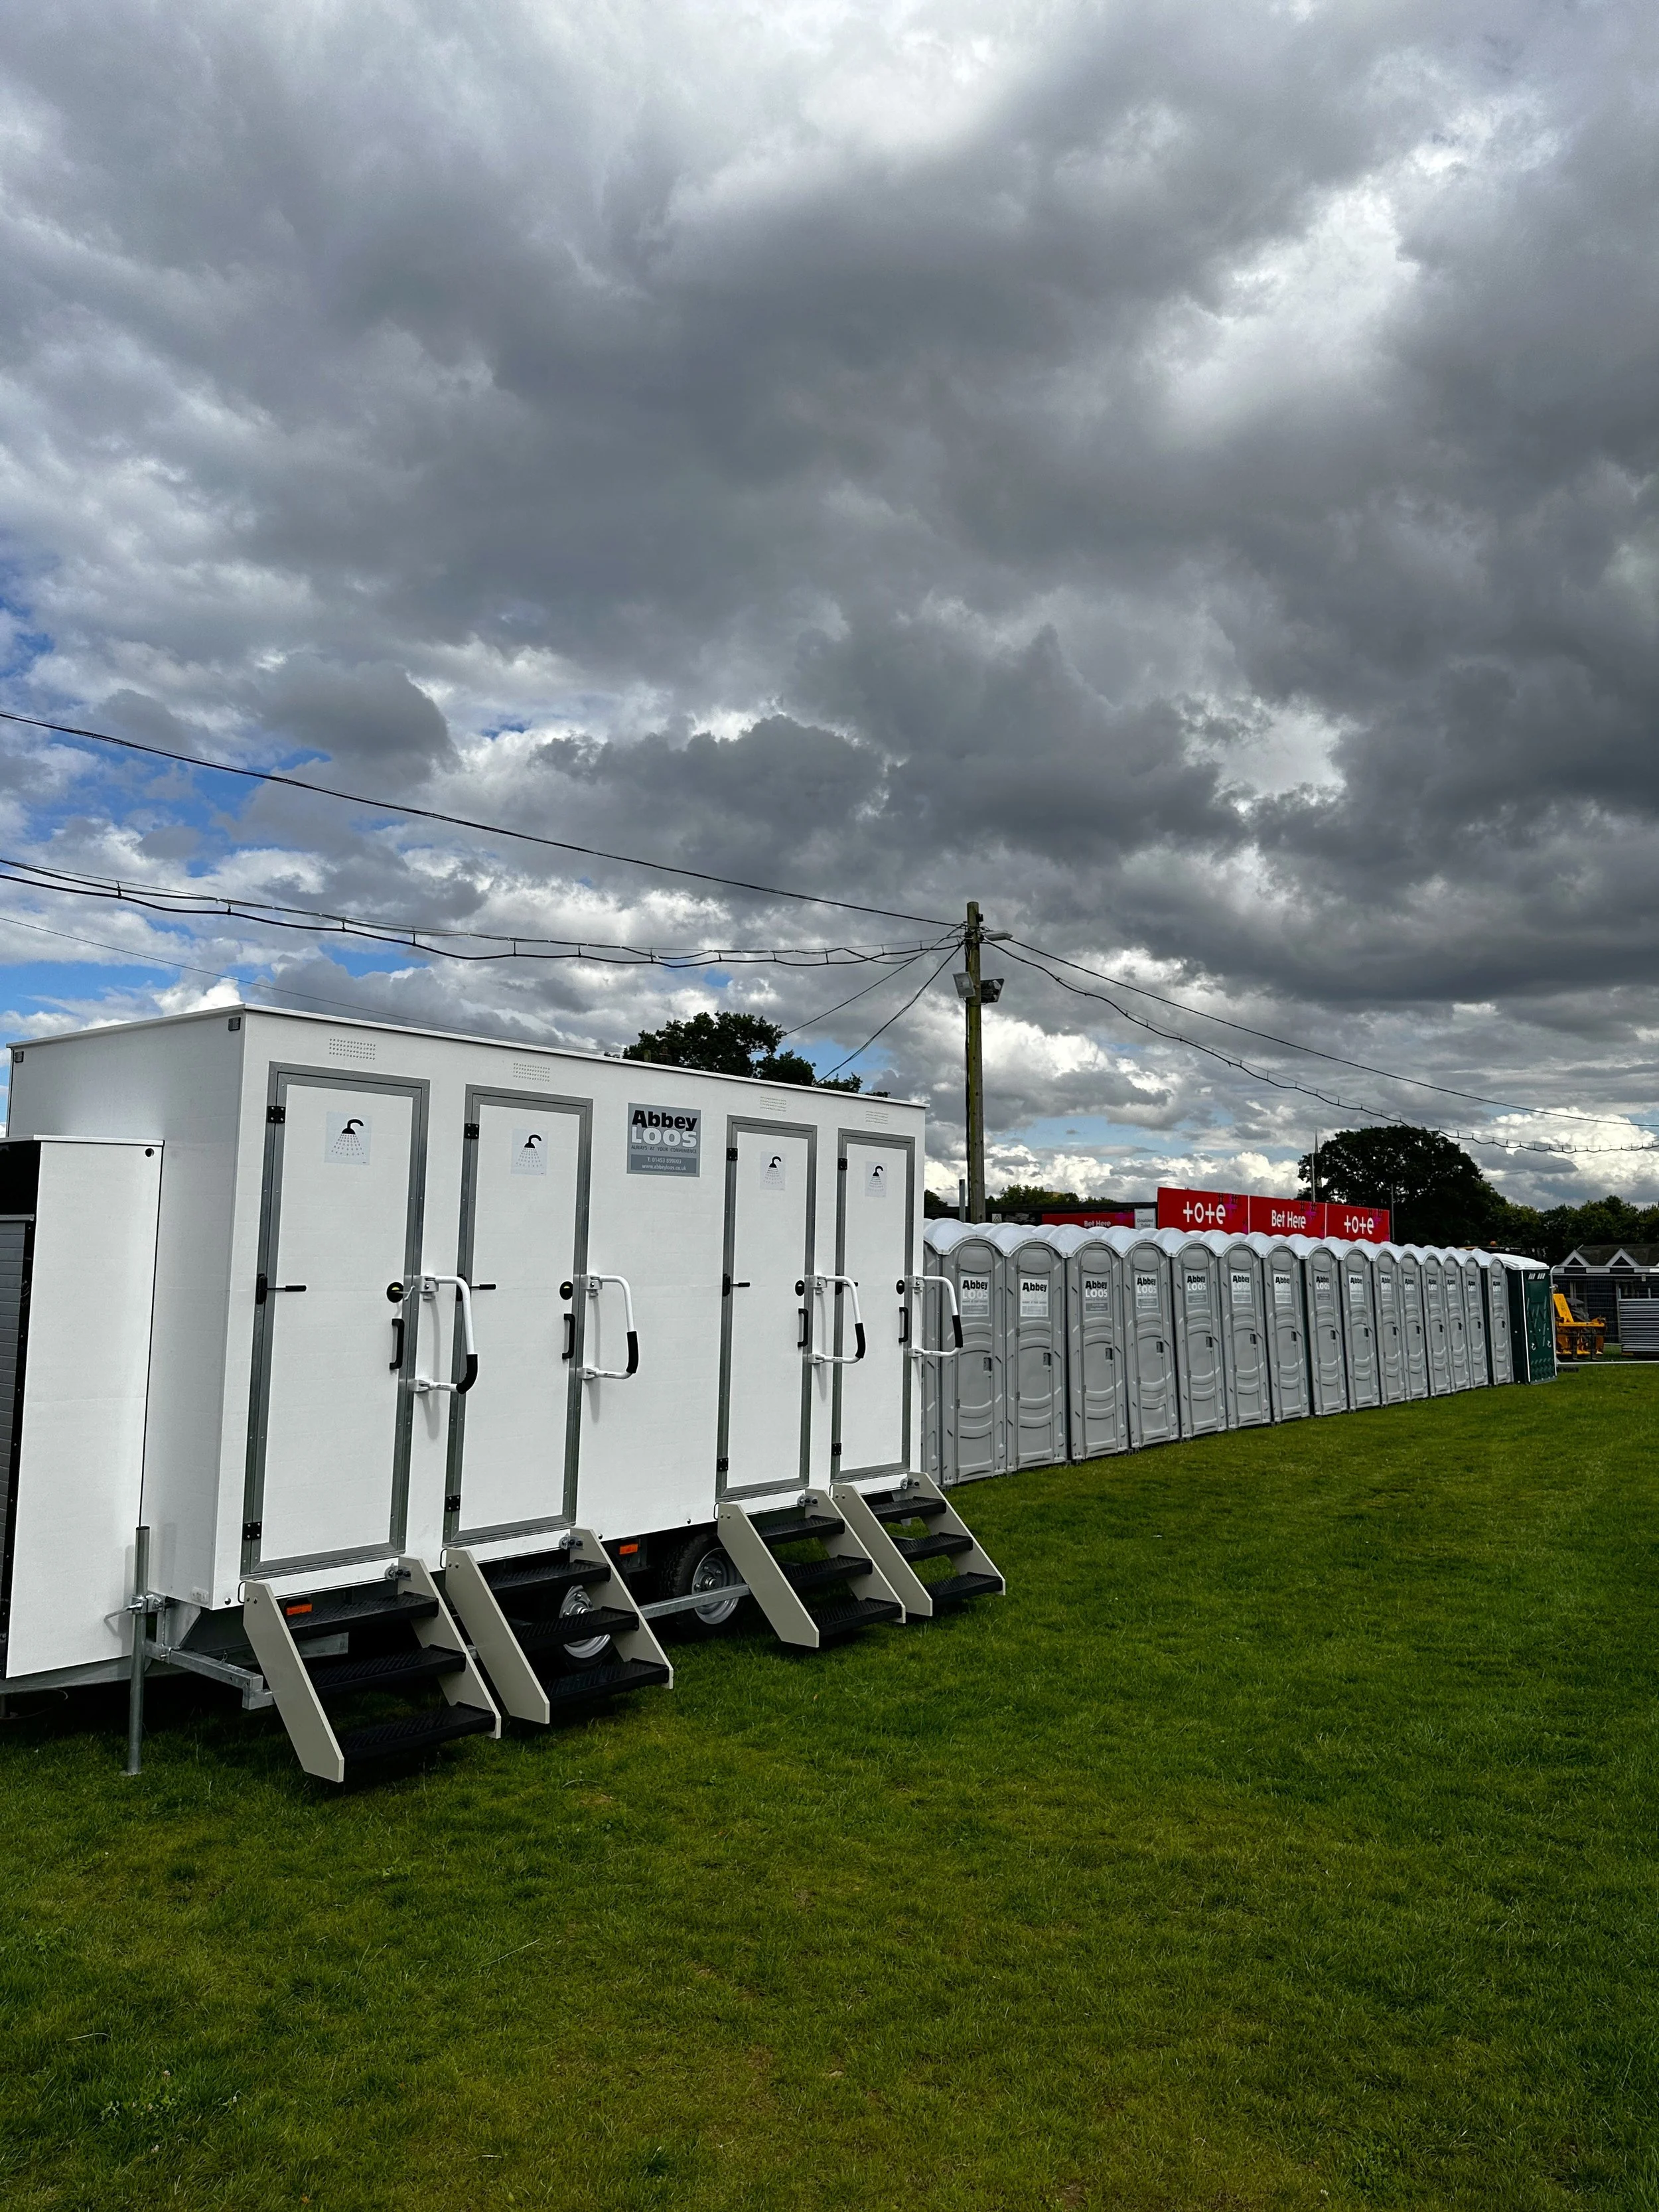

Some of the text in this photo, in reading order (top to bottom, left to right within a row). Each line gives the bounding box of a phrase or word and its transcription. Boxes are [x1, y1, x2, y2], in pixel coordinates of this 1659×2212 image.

[632, 1110, 697, 1131] Abbey
[632, 1126, 697, 1147] LOOS
[1183, 1201, 1226, 1224] tote
[1271, 1209, 1306, 1228] Bet Here
[1344, 1215, 1374, 1235] tote
[1137, 1277, 1156, 1286] Abbey
[1233, 1275, 1250, 1284] Abbey
[962, 1280, 988, 1290] Abbey
[1022, 1282, 1047, 1292] Abbey
[1085, 1281, 1107, 1290] Abbey
[962, 1290, 988, 1299] LOOS
[1085, 1289, 1108, 1297] LOOS
